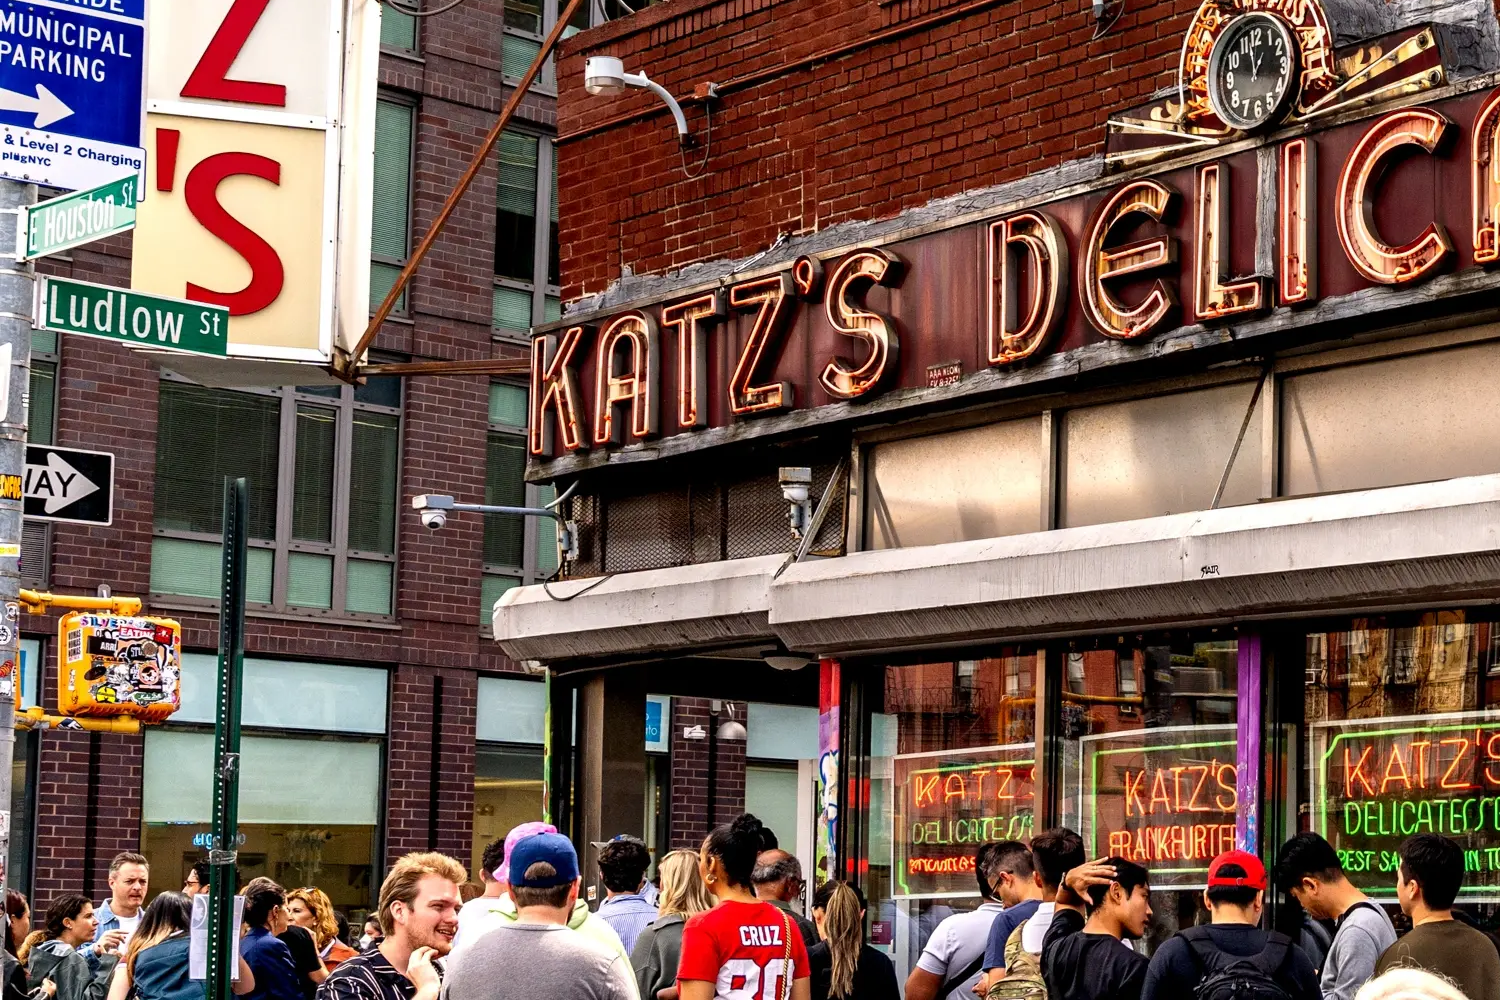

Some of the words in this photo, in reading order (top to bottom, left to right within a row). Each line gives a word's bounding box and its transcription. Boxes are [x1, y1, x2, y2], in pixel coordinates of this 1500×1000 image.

[0, 9, 132, 58] MUNICIPAL
[1250, 28, 1262, 48] 12
[1267, 29, 1273, 46] 1
[1240, 36, 1249, 55] 11
[1275, 38, 1283, 56] 2
[0, 40, 106, 83] PARKING
[1228, 51, 1240, 70] 10
[1279, 56, 1288, 75] 3
[1226, 71, 1235, 90] 9
[1275, 77, 1284, 94] 4
[1231, 90, 1240, 108] 8
[1241, 99, 1250, 117] 7
[1266, 92, 1274, 111] 5
[1254, 100, 1263, 118] 6
[20, 136, 59, 153] Level
[63, 144, 73, 156] 2
[77, 146, 142, 170] Charging
[29, 211, 39, 252] E
[43, 193, 115, 248] Houston
[121, 180, 134, 208] St
[50, 284, 184, 344] Ludlow
[199, 311, 221, 337] St
[530, 247, 906, 458] KATZ'S
[914, 767, 1036, 808] KATZ
[1125, 758, 1238, 817] KATZ'S
[739, 925, 783, 947] CRUZ
